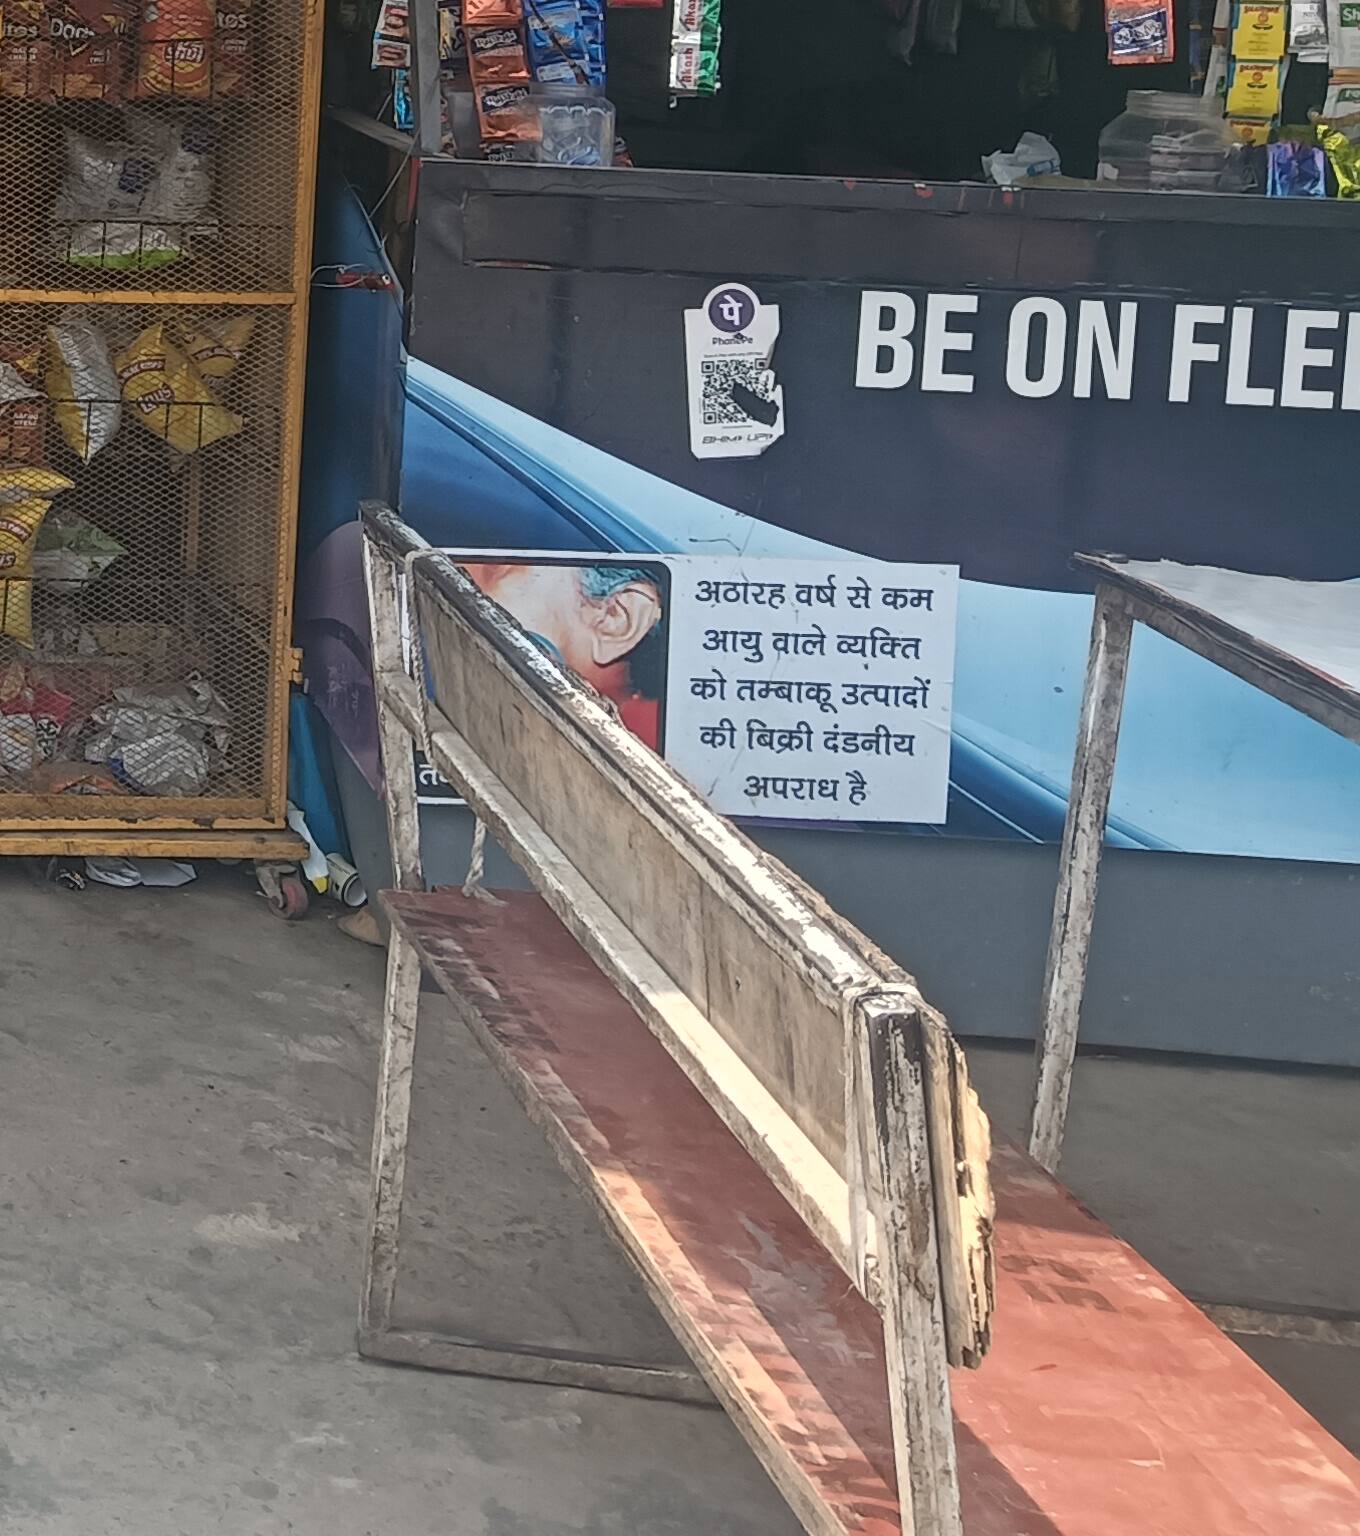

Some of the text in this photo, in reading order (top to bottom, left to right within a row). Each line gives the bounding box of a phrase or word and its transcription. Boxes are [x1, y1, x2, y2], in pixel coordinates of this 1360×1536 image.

[213, 11, 248, 29] tos
[855, 290, 979, 394] BE
[1005, 295, 1138, 400] ON
[694, 573, 934, 612] अठारह वर्ष से कम
[702, 623, 922, 663] आयु वाले व्यक्ति
[690, 669, 934, 715] को तम्बाकू उत्पादों
[700, 719, 916, 757] की बिक्री दंडनीय
[745, 770, 870, 806] अपराध है
